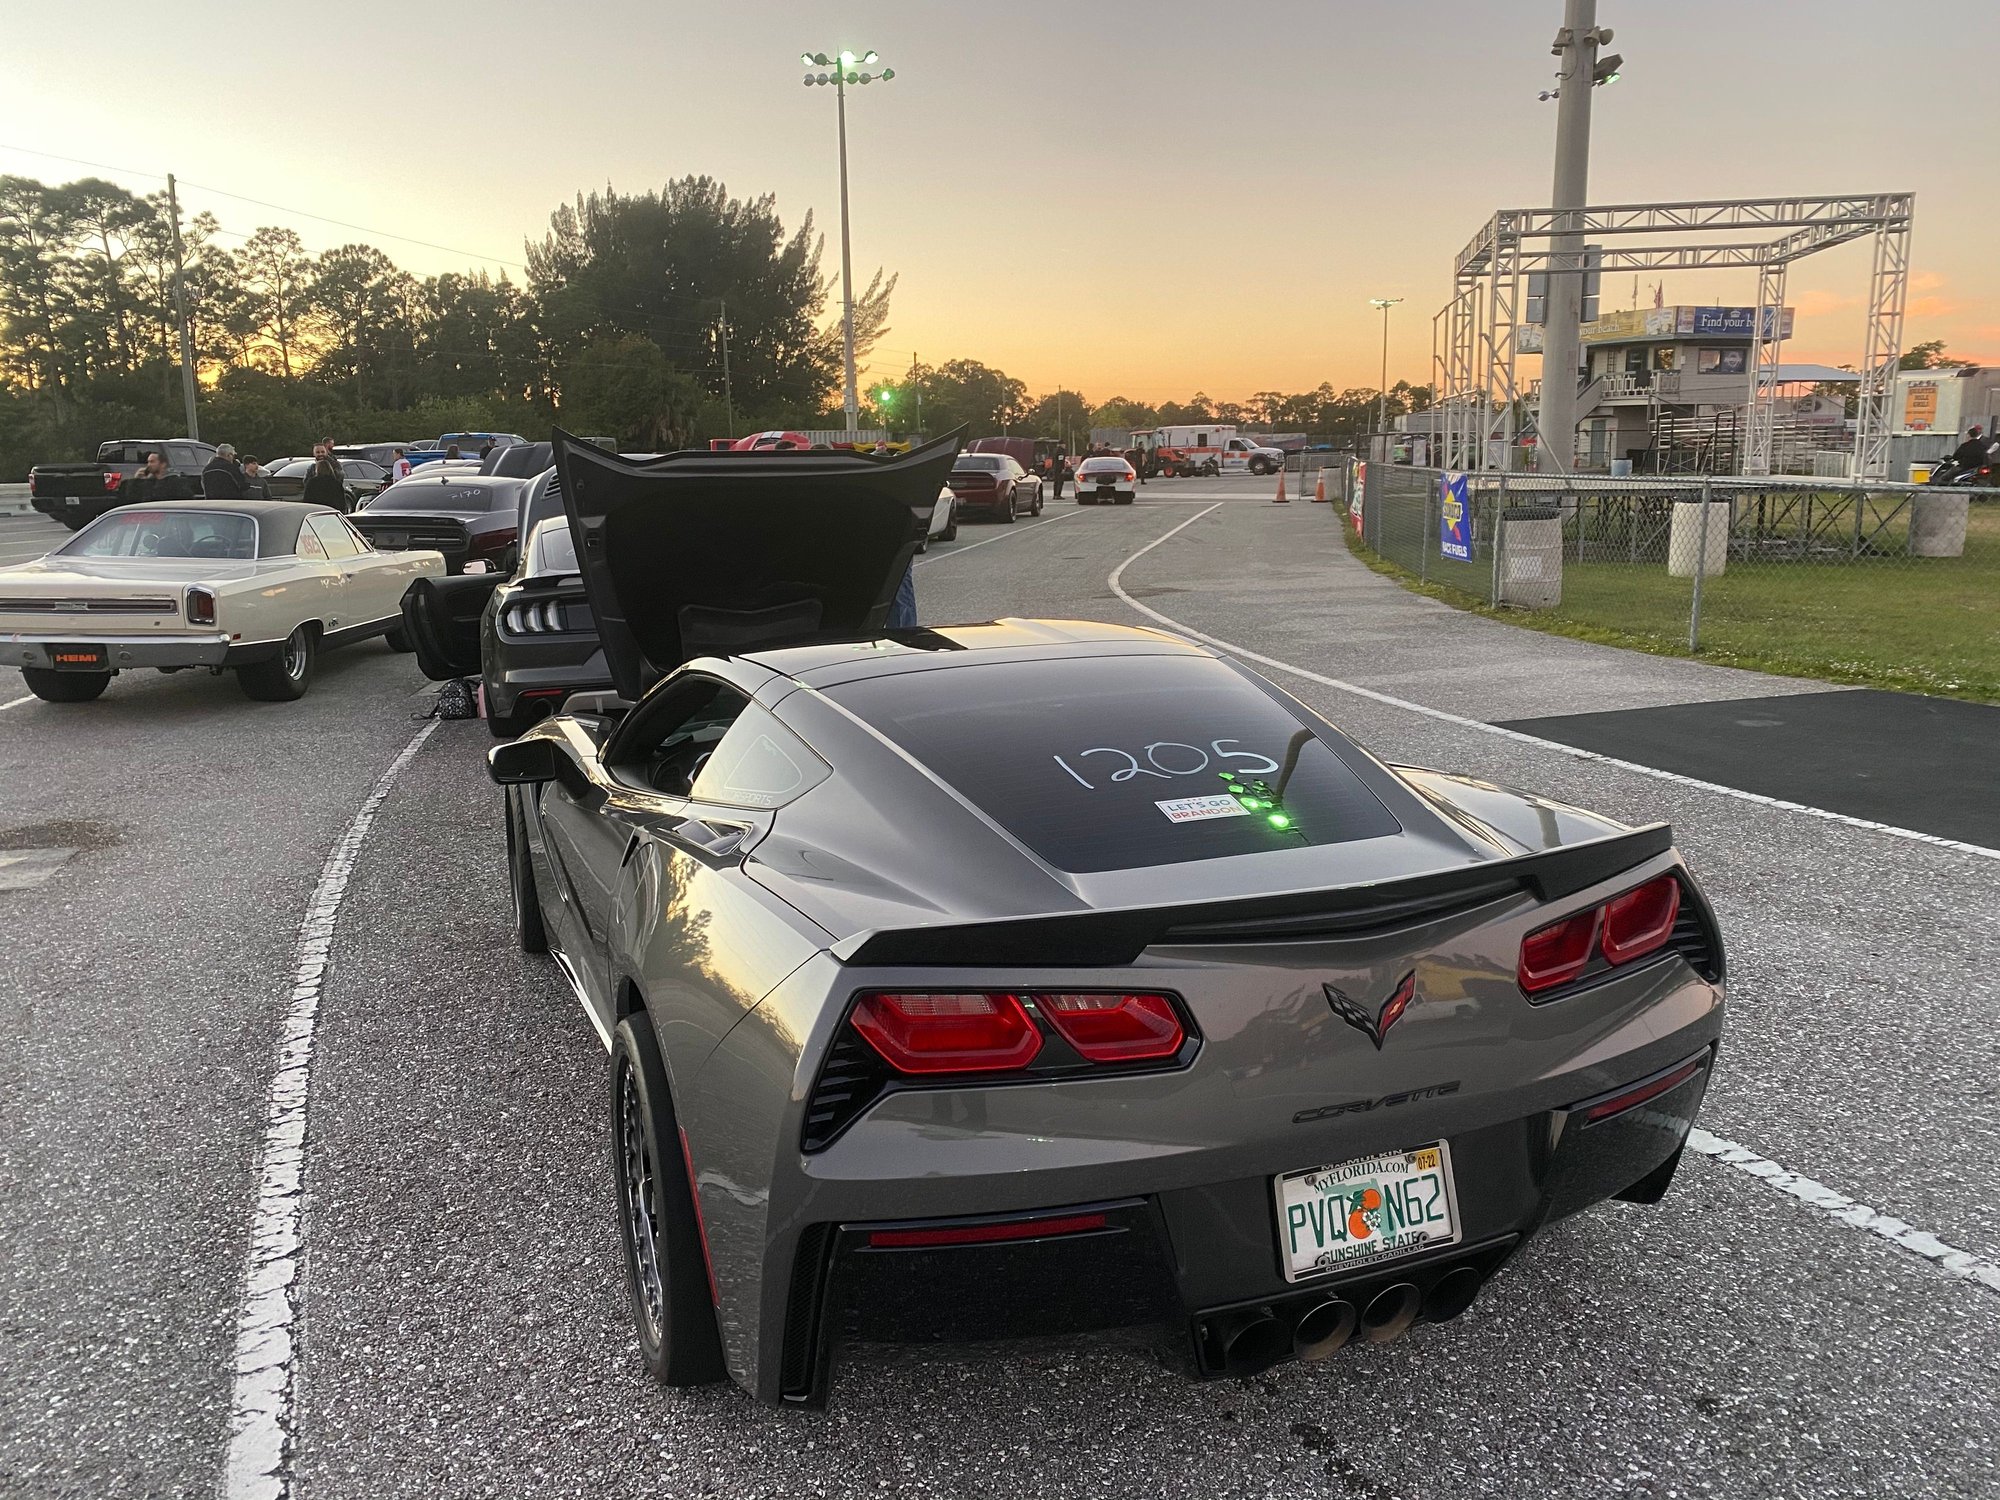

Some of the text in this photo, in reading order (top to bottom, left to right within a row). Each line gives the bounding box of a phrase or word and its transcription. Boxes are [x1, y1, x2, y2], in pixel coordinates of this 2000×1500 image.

[1702, 313, 1723, 327] Find
[1723, 319, 1745, 332] your
[1452, 544, 1467, 557] FUELS
[1054, 740, 1279, 789] 1205
[1167, 801, 1206, 812] LET'S
[1171, 806, 1243, 819] BRANDON
[1292, 1080, 1461, 1123] CORVETTE
[1417, 1154, 1436, 1170] 07-22
[1314, 1160, 1409, 1193] MYFLORIDA.COM
[1288, 1174, 1444, 1254] PVQ N62
[1323, 1230, 1418, 1263] SUNSHINE STATE
